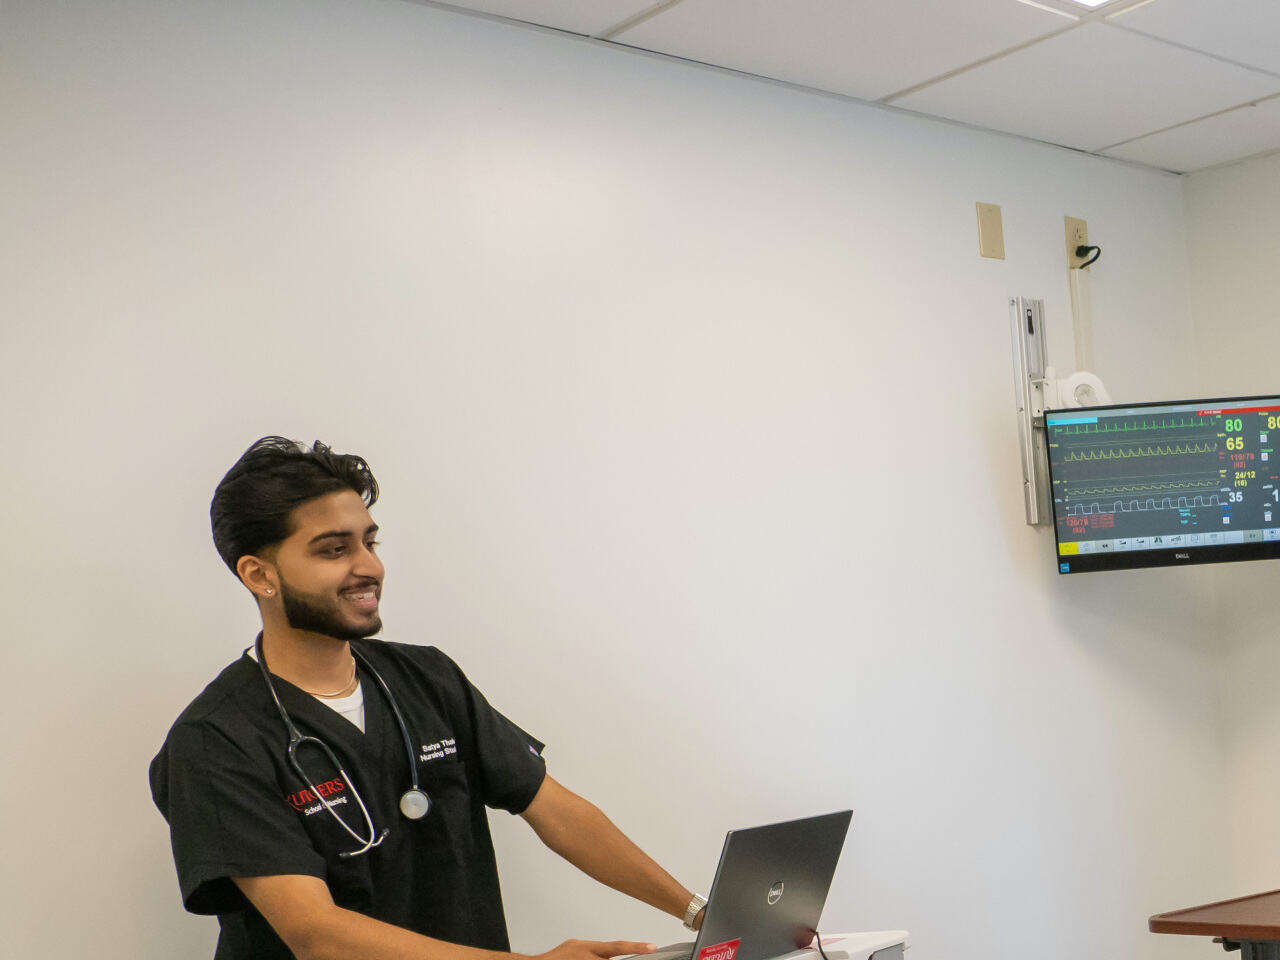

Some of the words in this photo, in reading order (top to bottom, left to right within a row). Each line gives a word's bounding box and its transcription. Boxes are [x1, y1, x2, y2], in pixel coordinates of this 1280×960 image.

[1225, 418, 1243, 432] 80
[1226, 436, 1244, 451] 65
[1234, 470, 1256, 479] 24/12
[1228, 491, 1244, 503] 35
[420, 750, 445, 762] Nursing
